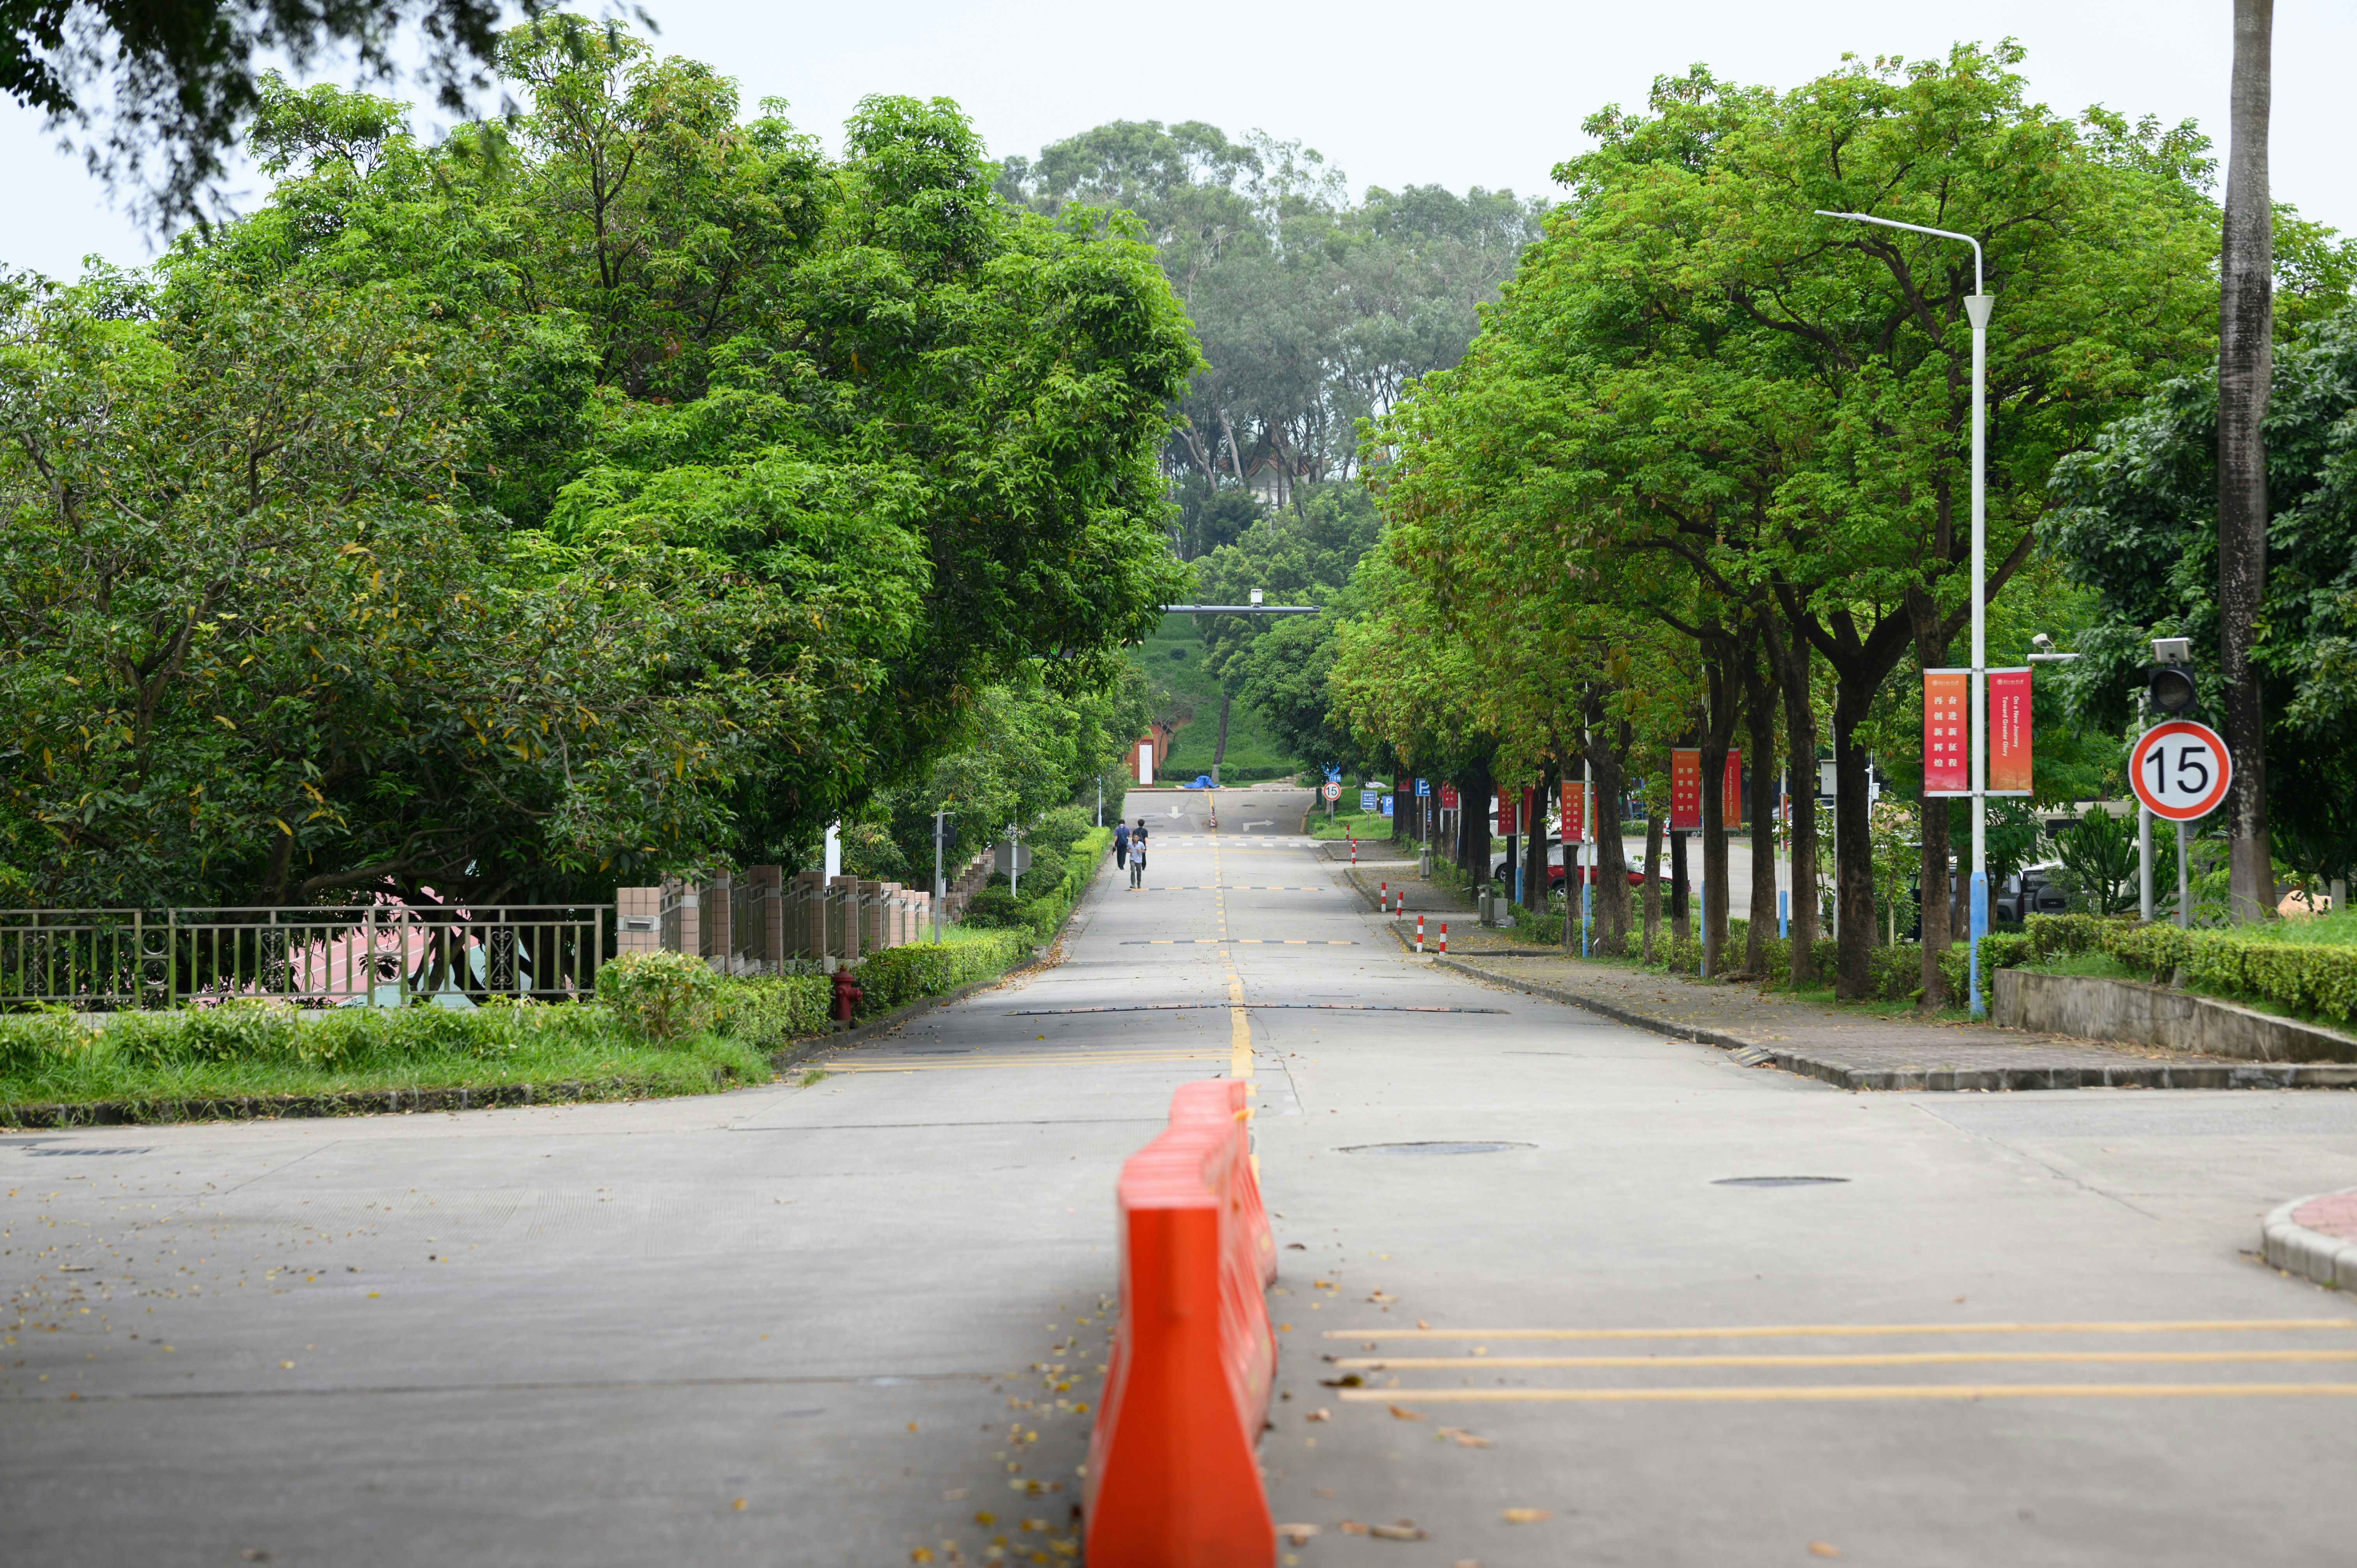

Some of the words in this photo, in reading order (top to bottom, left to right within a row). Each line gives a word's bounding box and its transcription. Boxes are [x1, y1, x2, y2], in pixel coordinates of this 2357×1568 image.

[2013, 696, 2020, 705] On
[1934, 696, 1943, 767] 再创新辉煌
[1948, 696, 1958, 767] 奋进新征程
[2146, 747, 2208, 793] 15
[1326, 786, 1337, 796] 15
[1419, 780, 1429, 794] P
[1386, 798, 1392, 807] P
